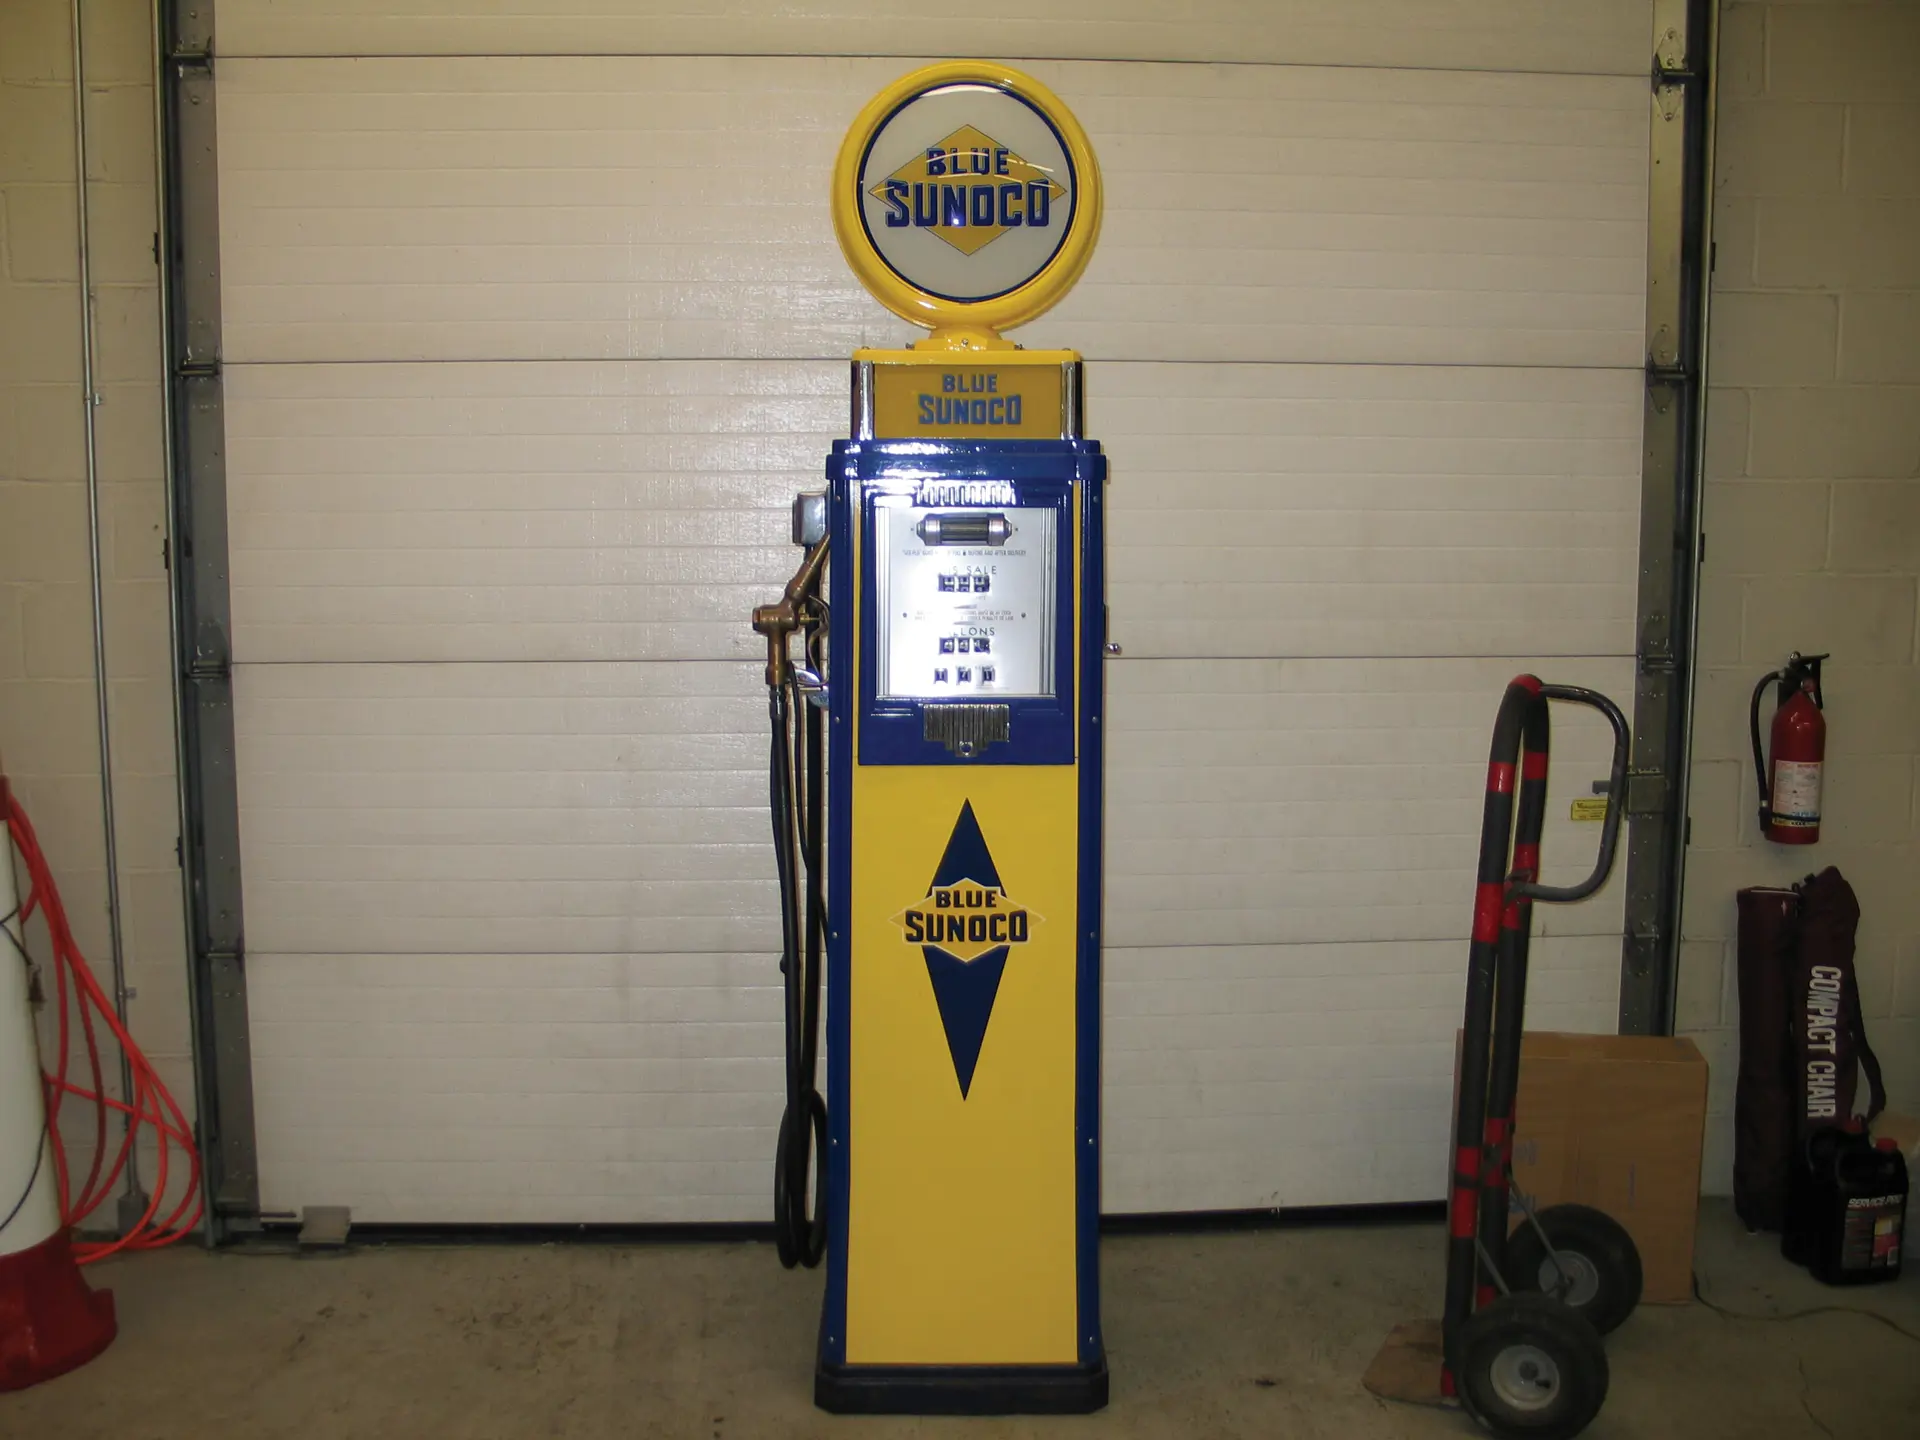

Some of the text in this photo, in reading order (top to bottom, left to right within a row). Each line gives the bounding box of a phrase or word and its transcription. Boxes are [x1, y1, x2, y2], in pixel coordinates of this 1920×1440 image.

[926, 148, 1009, 175] BLUE
[885, 179, 1049, 227] SUNOCO
[942, 374, 998, 393] BLUE
[918, 394, 1021, 425] SUNOCO
[966, 565, 997, 575] SALE
[936, 890, 997, 908] BLUE
[905, 910, 1028, 942] SUNOCO
[1807, 966, 1842, 1118] COMPACT CHAIR
